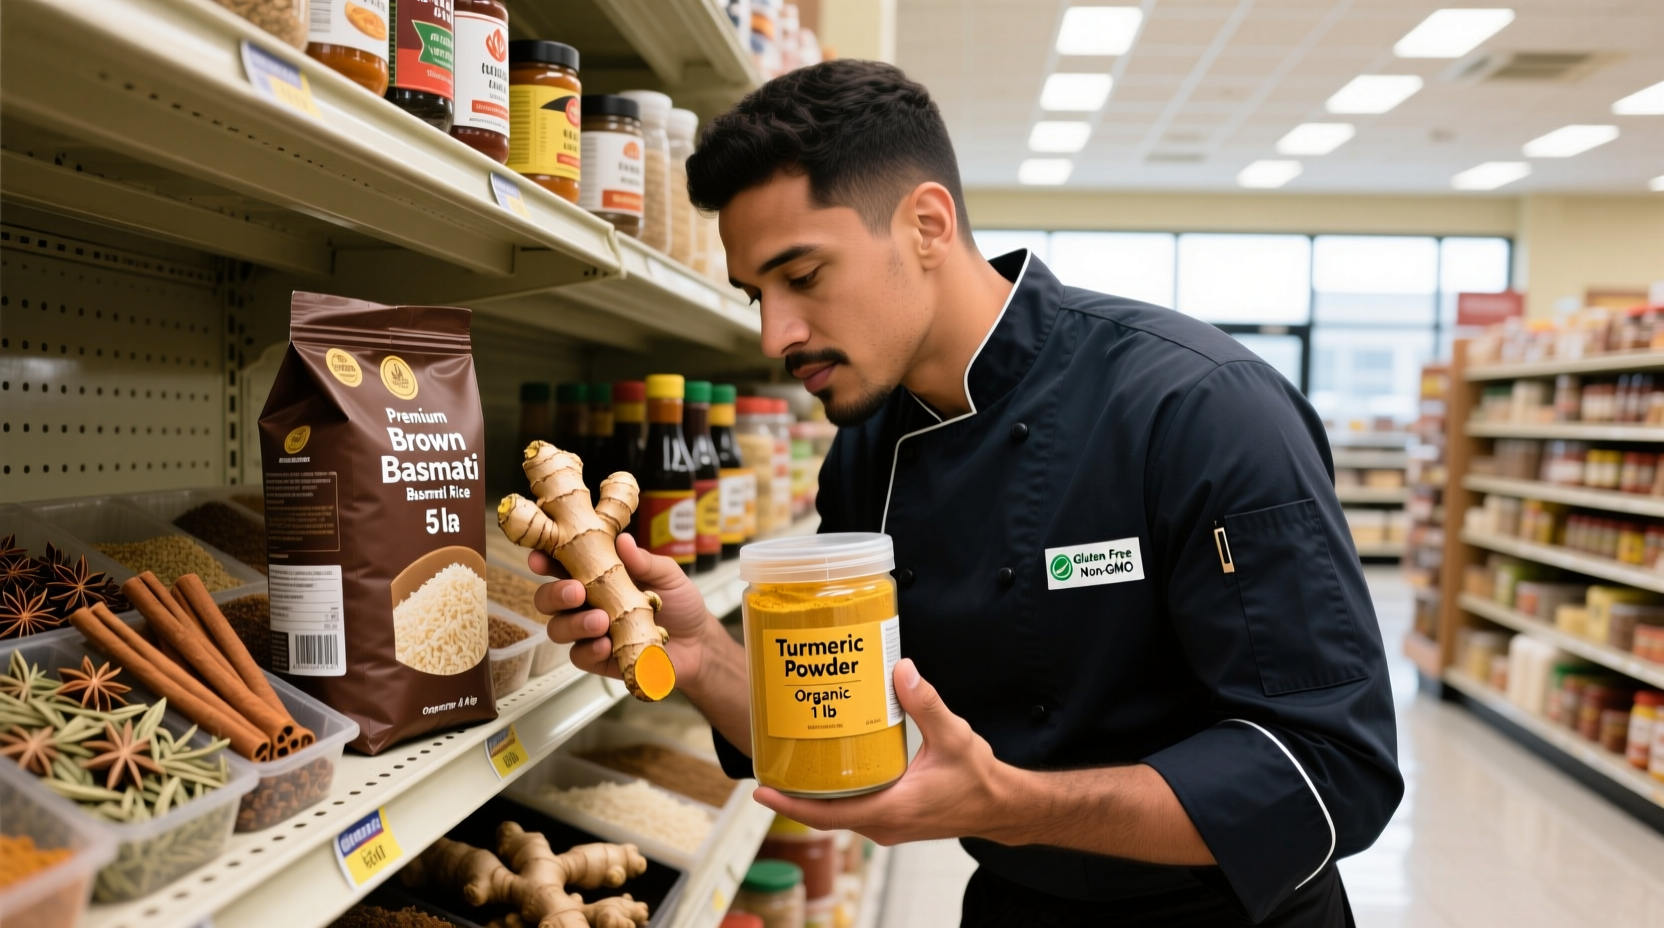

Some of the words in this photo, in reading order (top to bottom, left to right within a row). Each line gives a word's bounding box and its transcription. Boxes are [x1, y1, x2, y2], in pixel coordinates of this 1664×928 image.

[385, 407, 447, 424] Premium
[386, 427, 467, 452] Brown
[381, 453, 479, 483] Basmati
[426, 508, 440, 534] 5
[1073, 552, 1106, 564] Gluten
[1108, 549, 1132, 560] Free
[1080, 561, 1133, 578] Non-GMO
[775, 633, 864, 657] Turmeric
[784, 656, 859, 678] Powder
[794, 687, 851, 705] Organic
[811, 706, 817, 719] 1
[822, 704, 837, 718] lb
